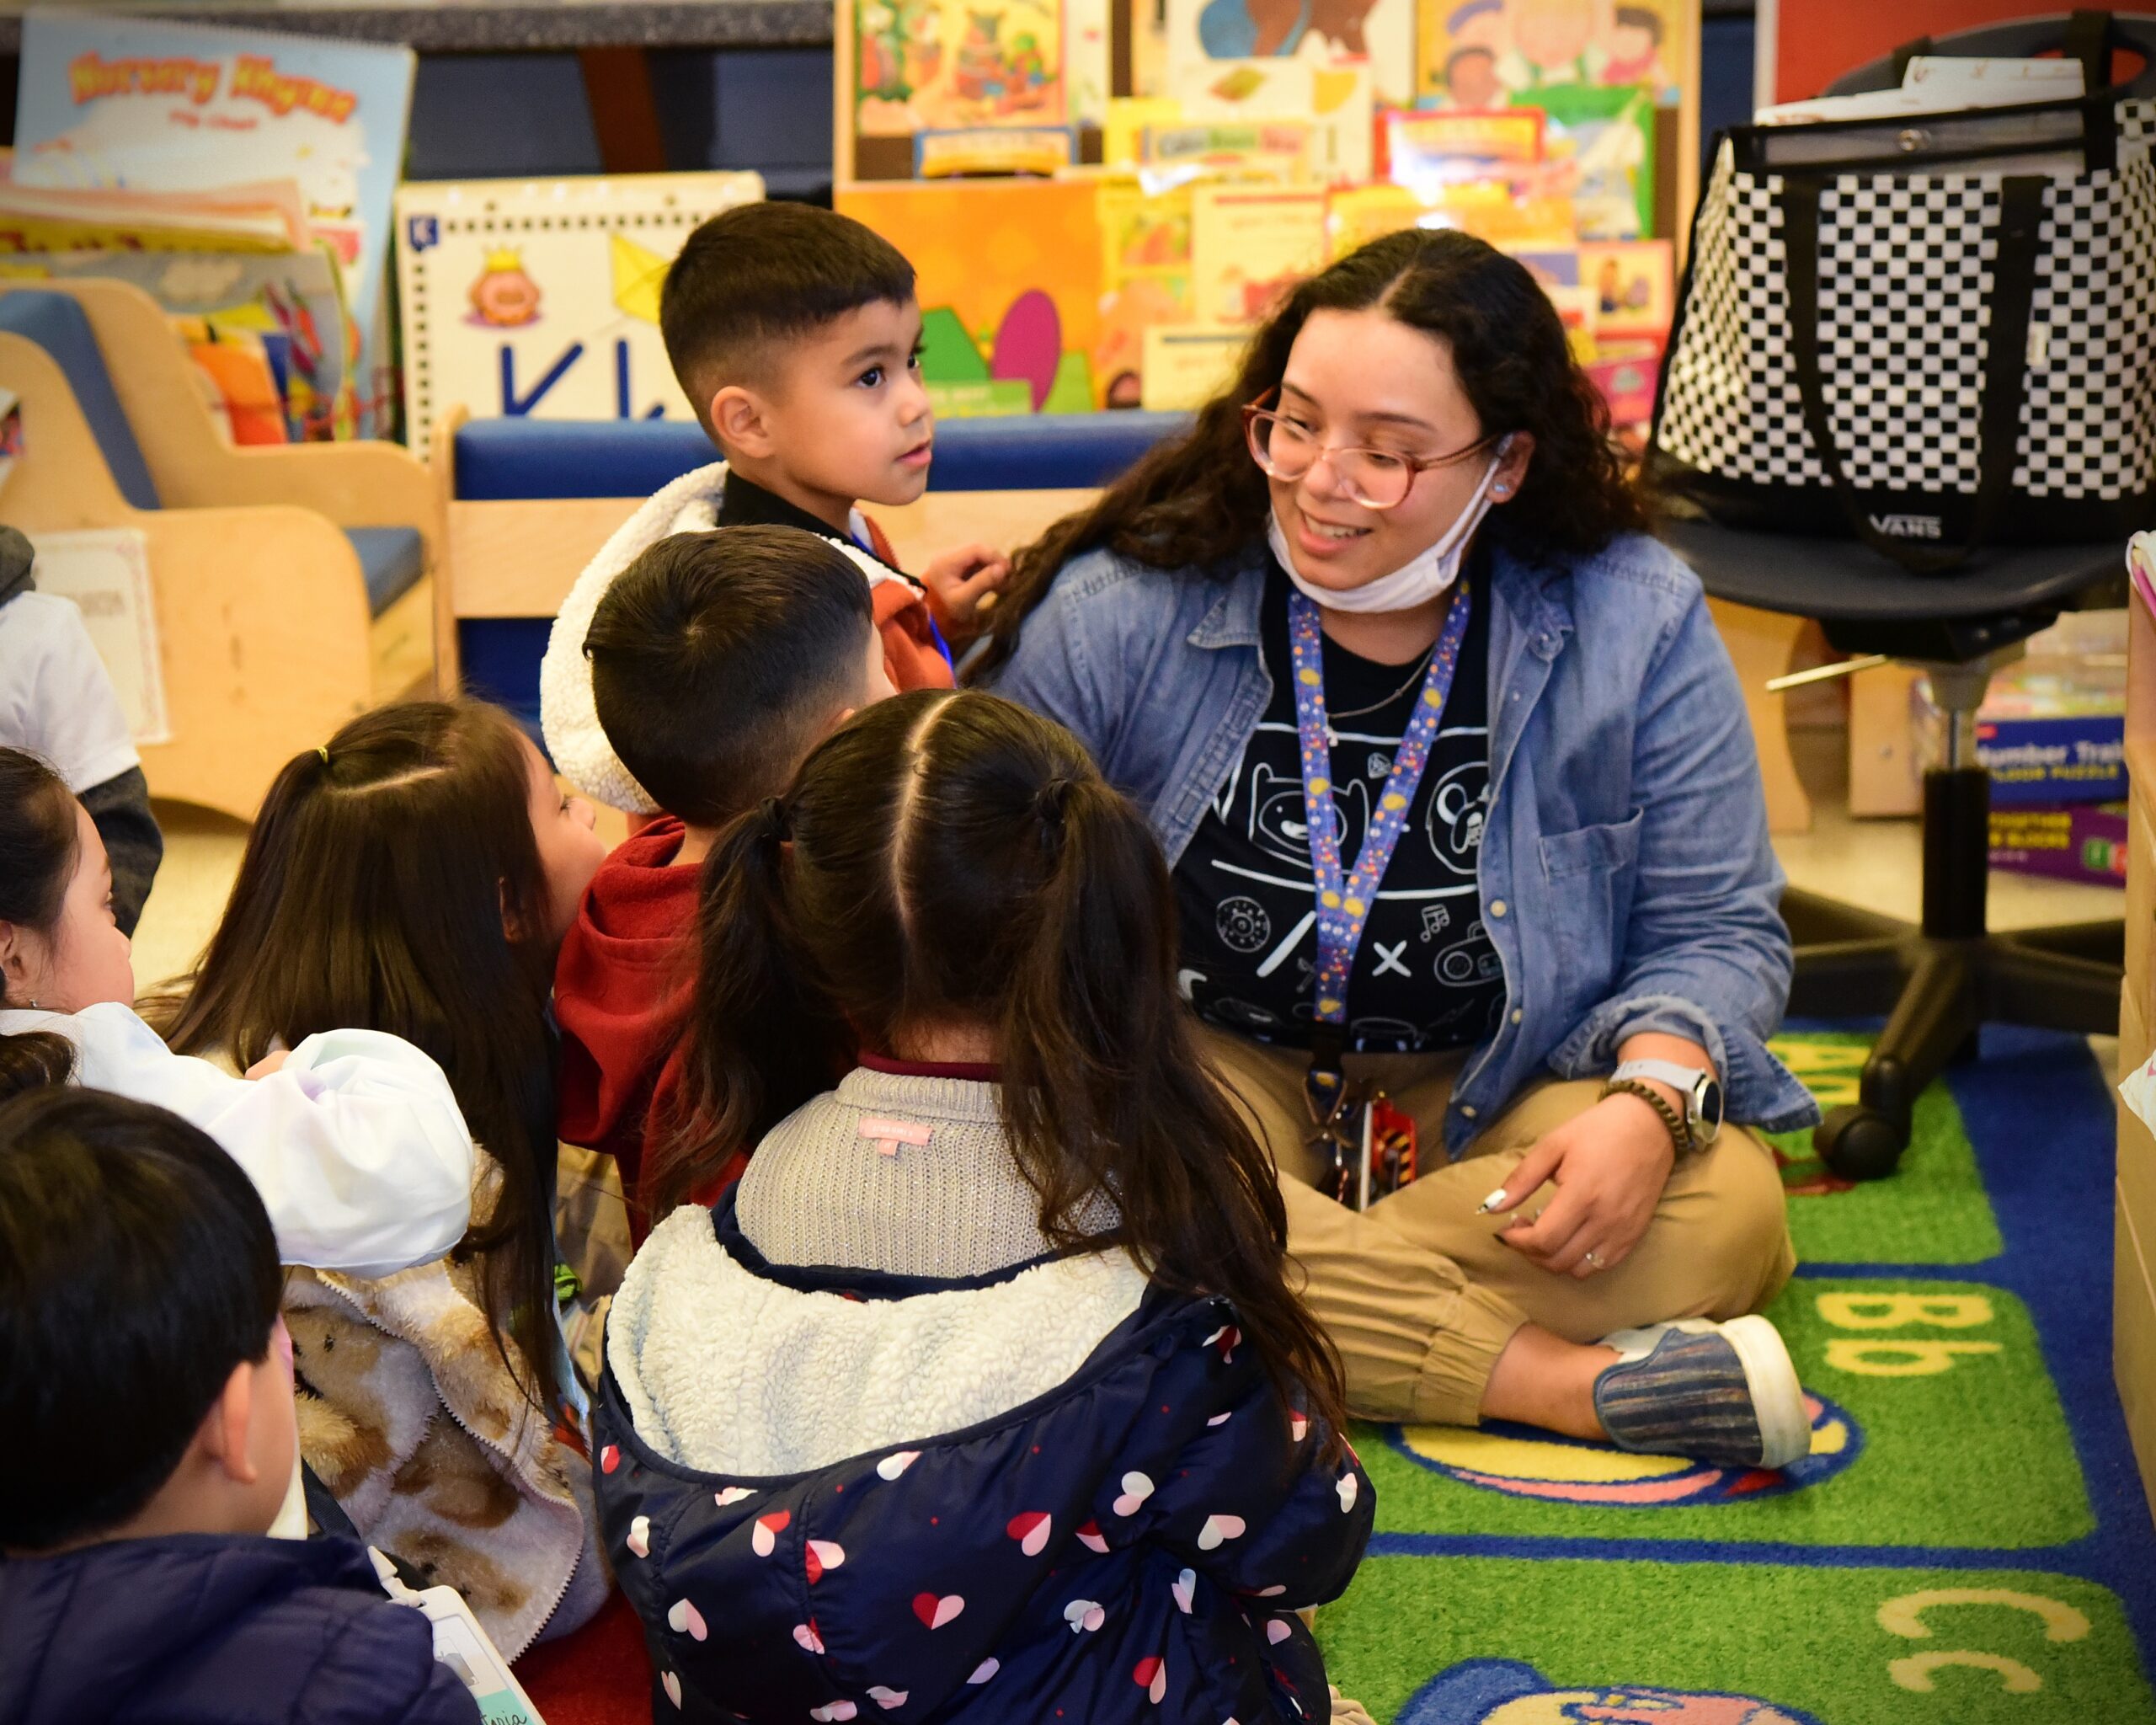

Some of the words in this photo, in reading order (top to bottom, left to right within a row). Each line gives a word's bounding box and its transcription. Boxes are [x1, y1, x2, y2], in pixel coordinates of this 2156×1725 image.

[1869, 513, 1940, 538] VANS
[1815, 1292, 2003, 1376] Bb
[1876, 1588, 2092, 1694] Cc
